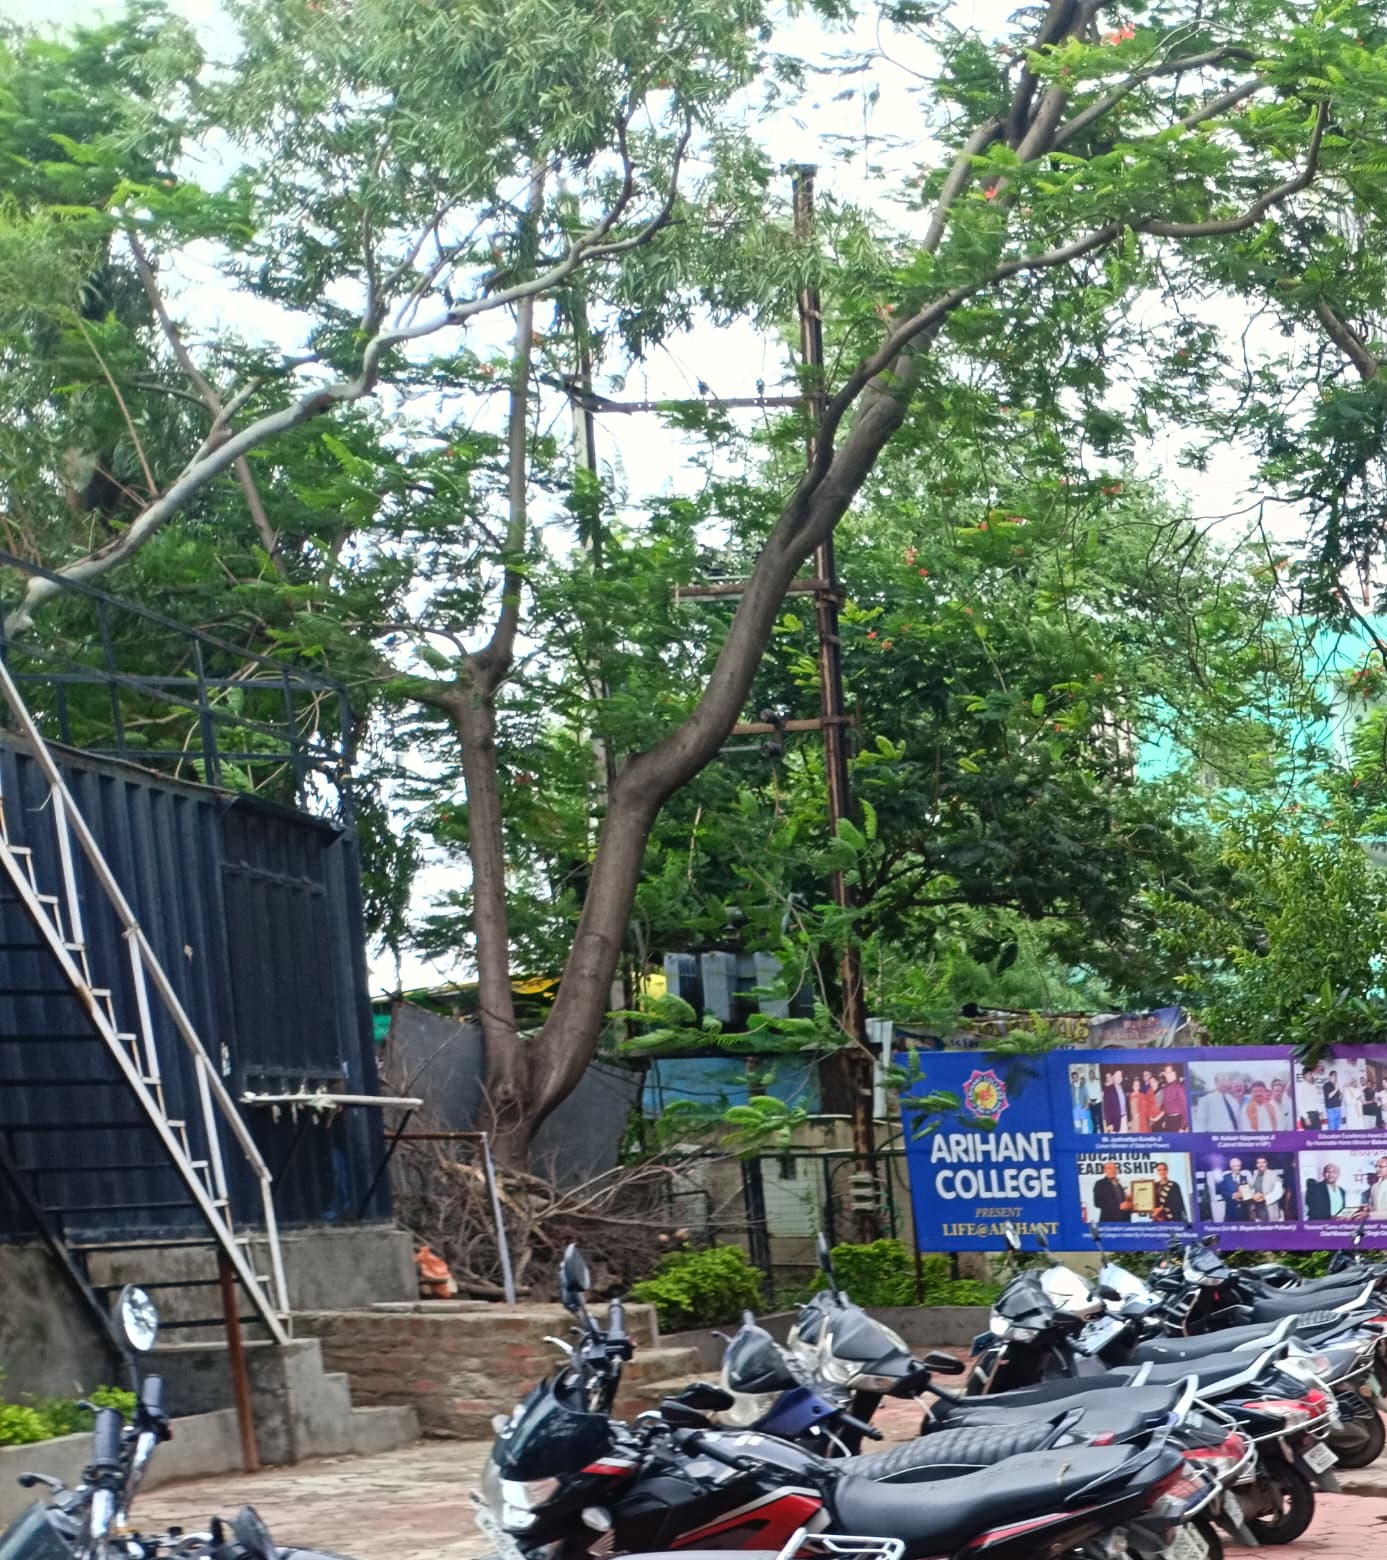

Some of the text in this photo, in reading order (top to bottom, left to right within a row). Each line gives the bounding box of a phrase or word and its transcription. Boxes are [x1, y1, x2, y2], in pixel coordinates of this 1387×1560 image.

[931, 1132, 1054, 1163] ARIHANT
[936, 1168, 1057, 1199] COLLEGE
[976, 1207, 1023, 1218] PRESENT
[943, 1222, 1059, 1238] LIFE@AHANT
